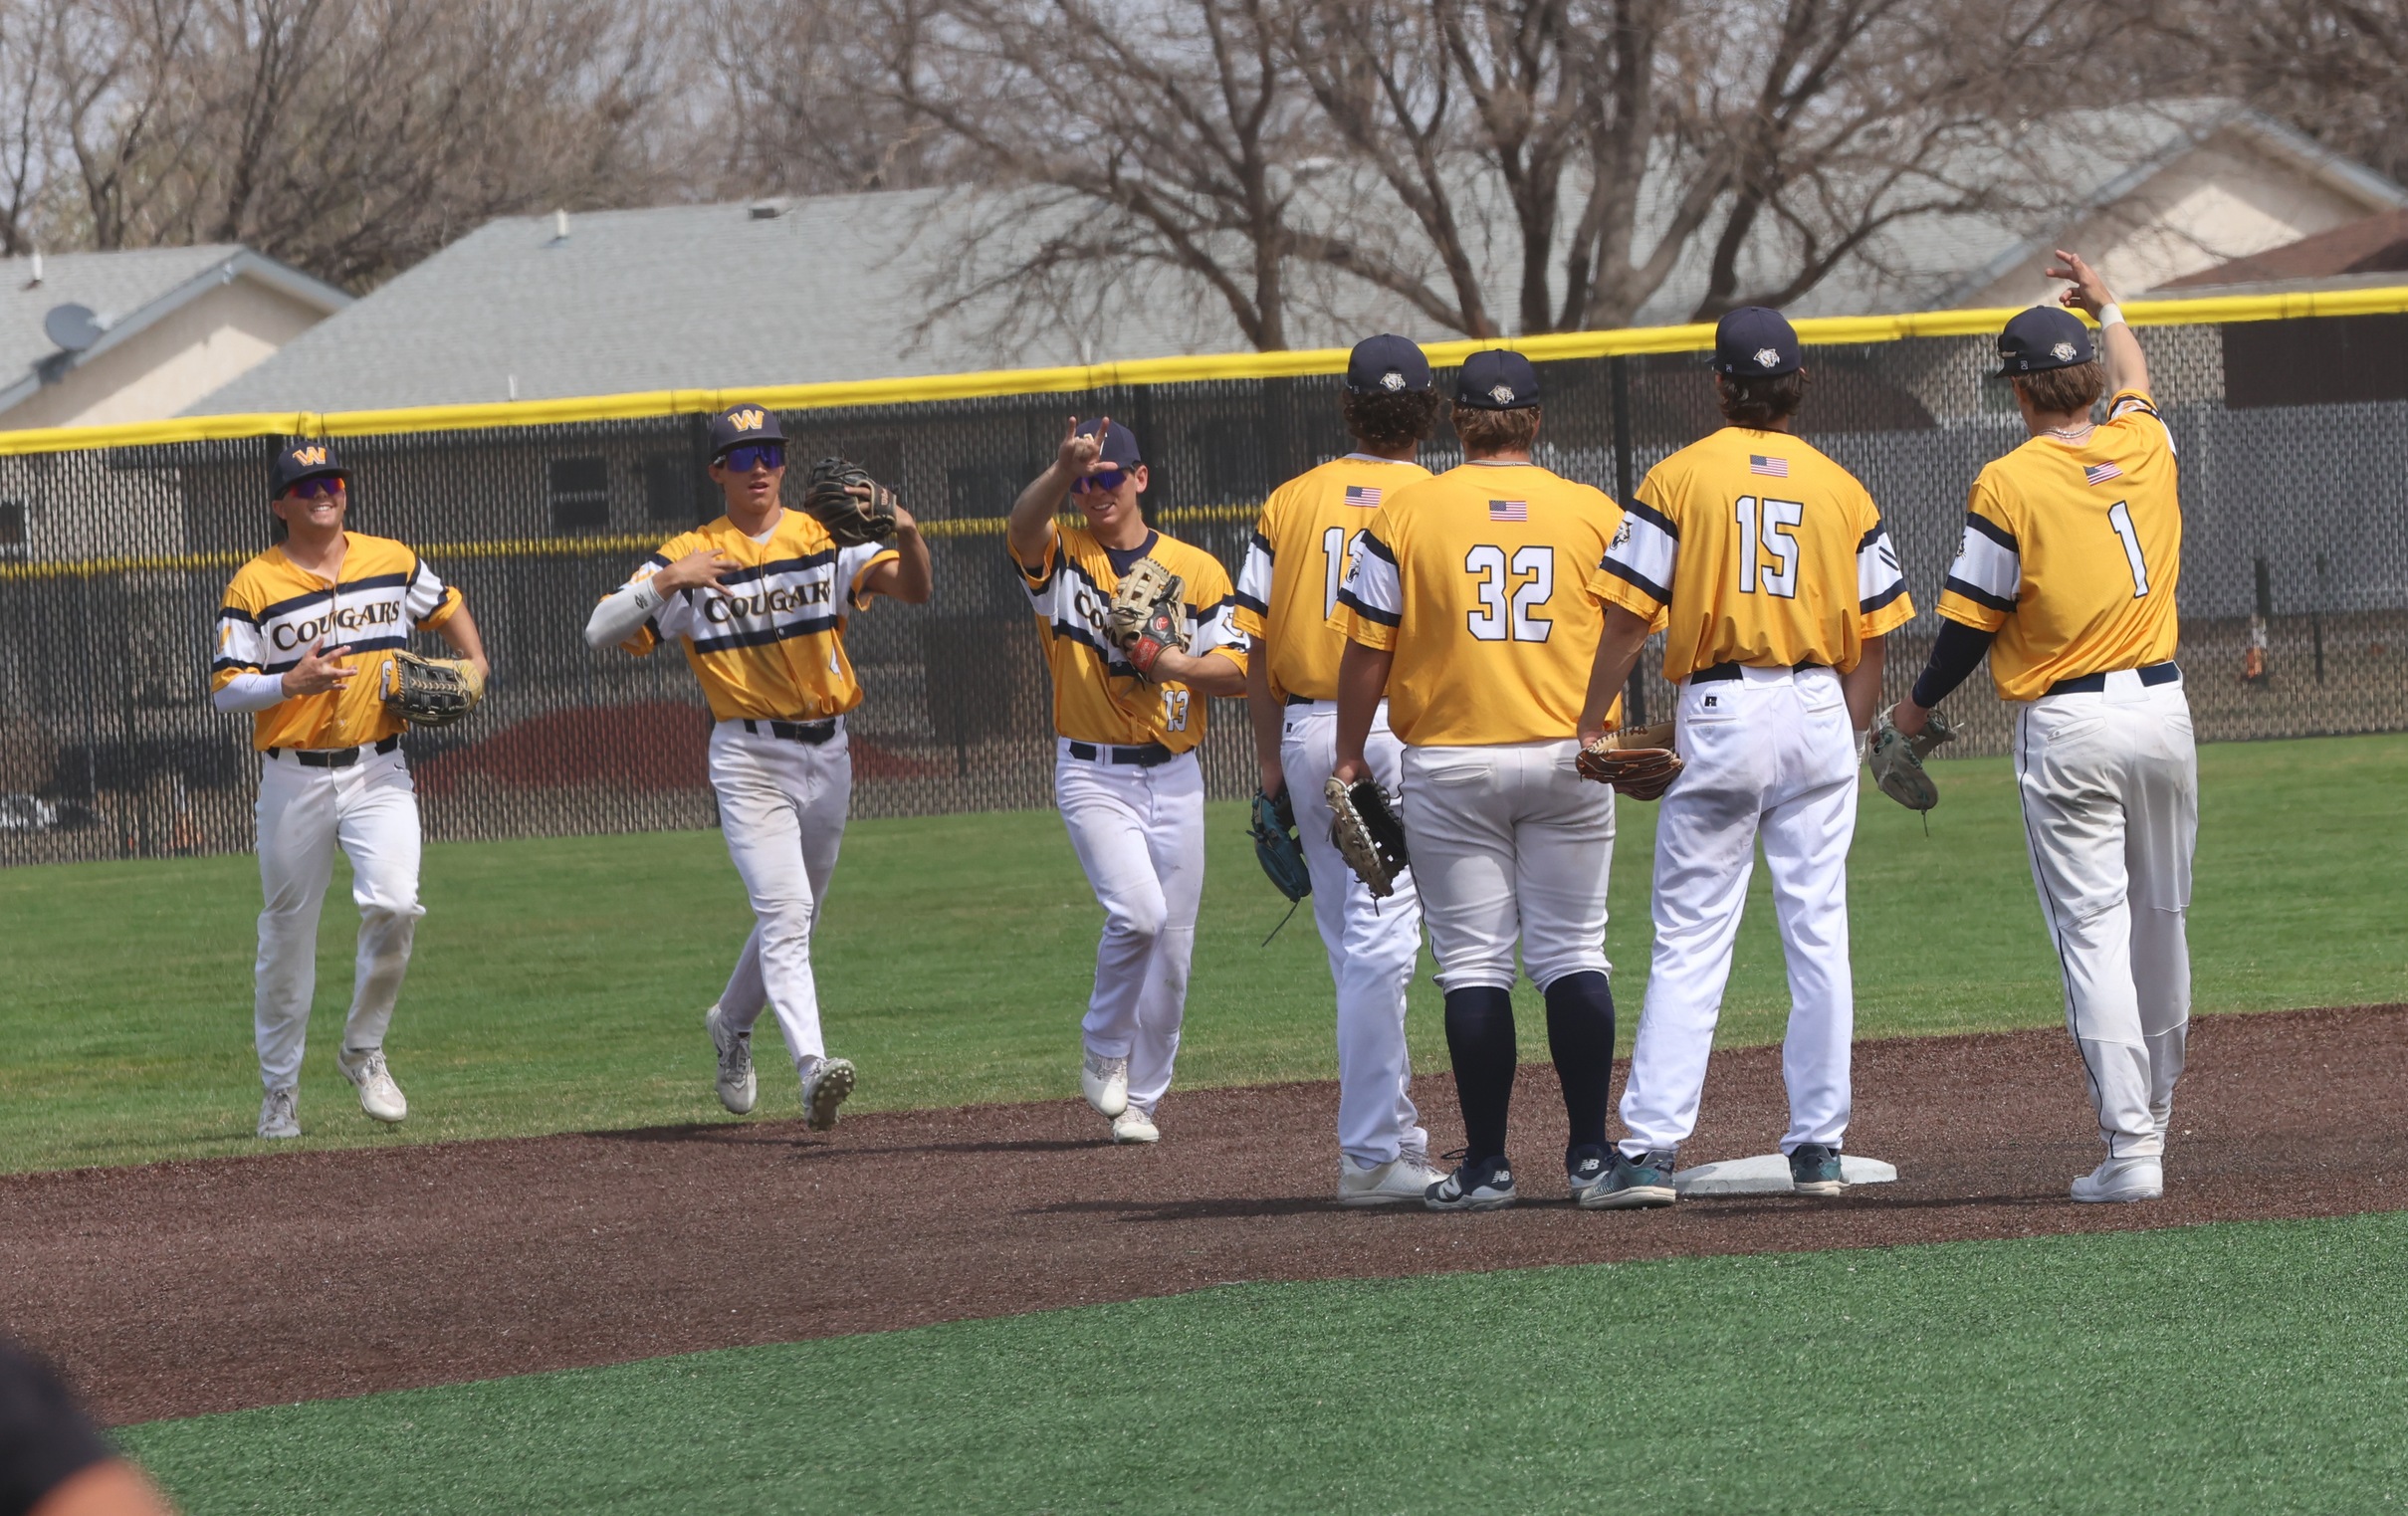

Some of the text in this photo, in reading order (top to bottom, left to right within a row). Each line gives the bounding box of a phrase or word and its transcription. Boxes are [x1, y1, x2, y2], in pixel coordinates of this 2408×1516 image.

[728, 409, 765, 432] W
[292, 446, 327, 467] W
[1735, 495, 1804, 599] 15
[2107, 500, 2149, 599] 1
[1464, 543, 1554, 643] 32
[272, 599, 400, 651] COUGARS
[1164, 689, 1191, 733] 13
